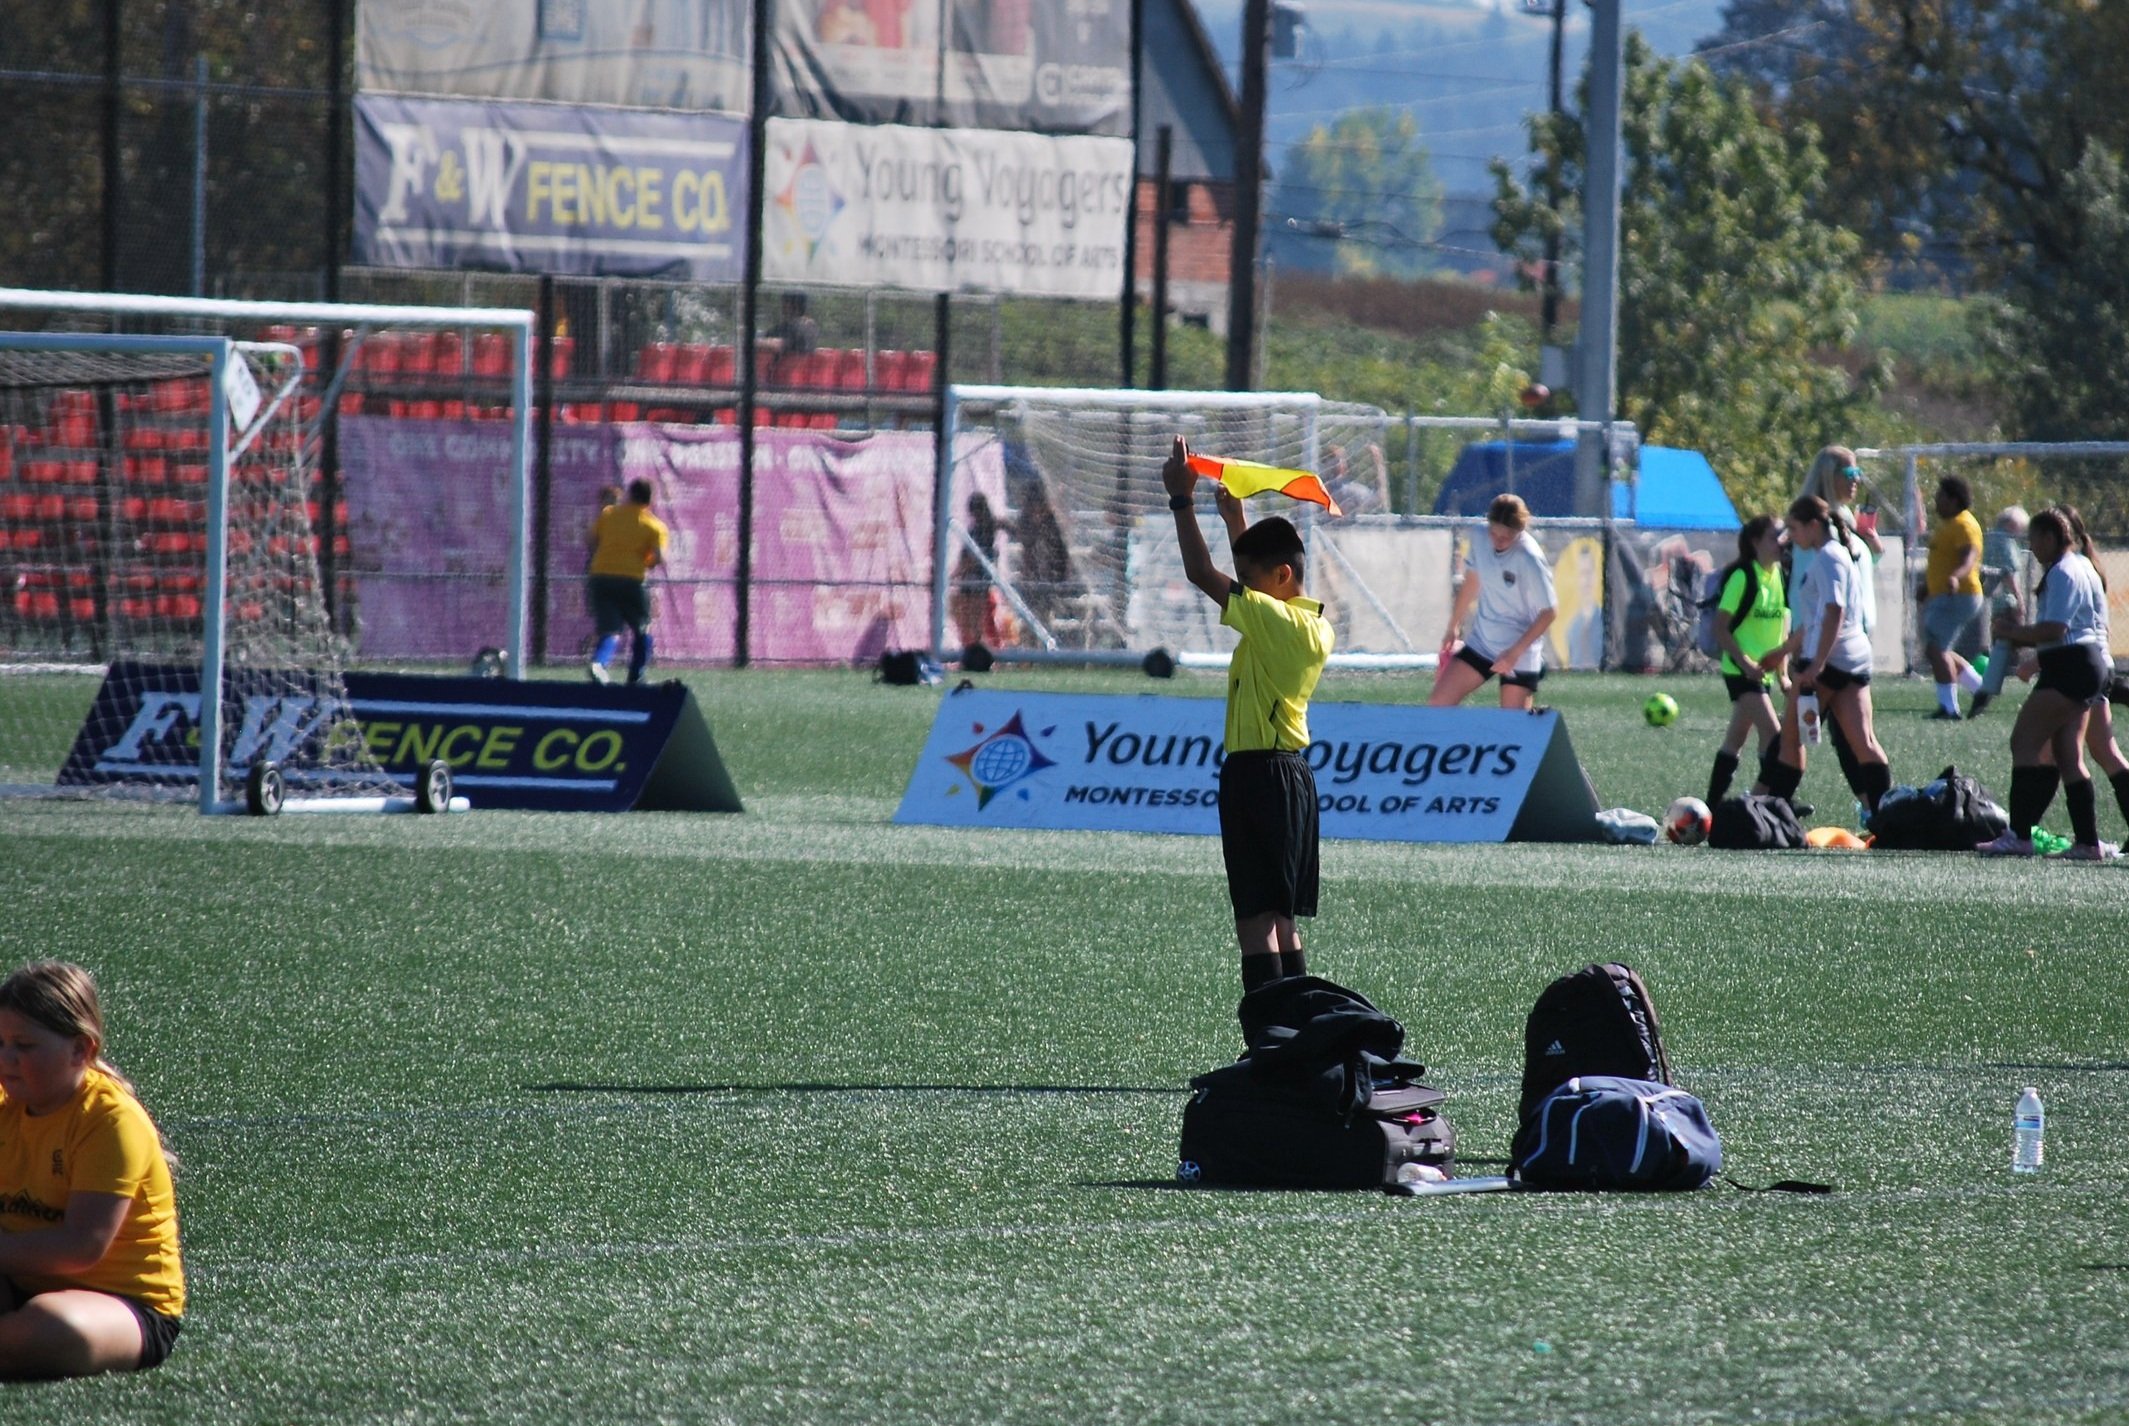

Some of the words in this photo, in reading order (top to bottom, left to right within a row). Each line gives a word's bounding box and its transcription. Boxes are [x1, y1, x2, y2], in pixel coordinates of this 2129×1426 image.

[378, 123, 438, 225] F
[434, 150, 464, 203] &
[461, 126, 526, 232] W
[526, 160, 664, 230] FENCE
[856, 141, 964, 222] Young
[974, 150, 1125, 229] Voyagers
[982, 241, 1047, 267] SCHOOL
[1052, 245, 1077, 268] OF
[1079, 247, 1118, 269] ARTS
[101, 691, 202, 760] F
[230, 695, 350, 766] W
[533, 728, 628, 772] CO.
[1301, 738, 1522, 786] oyagers
[1064, 785, 1221, 807] MONTESSO
[1318, 794, 1371, 813] OOL
[1380, 795, 1422, 815] OF
[1424, 796, 1501, 815] ARTS
